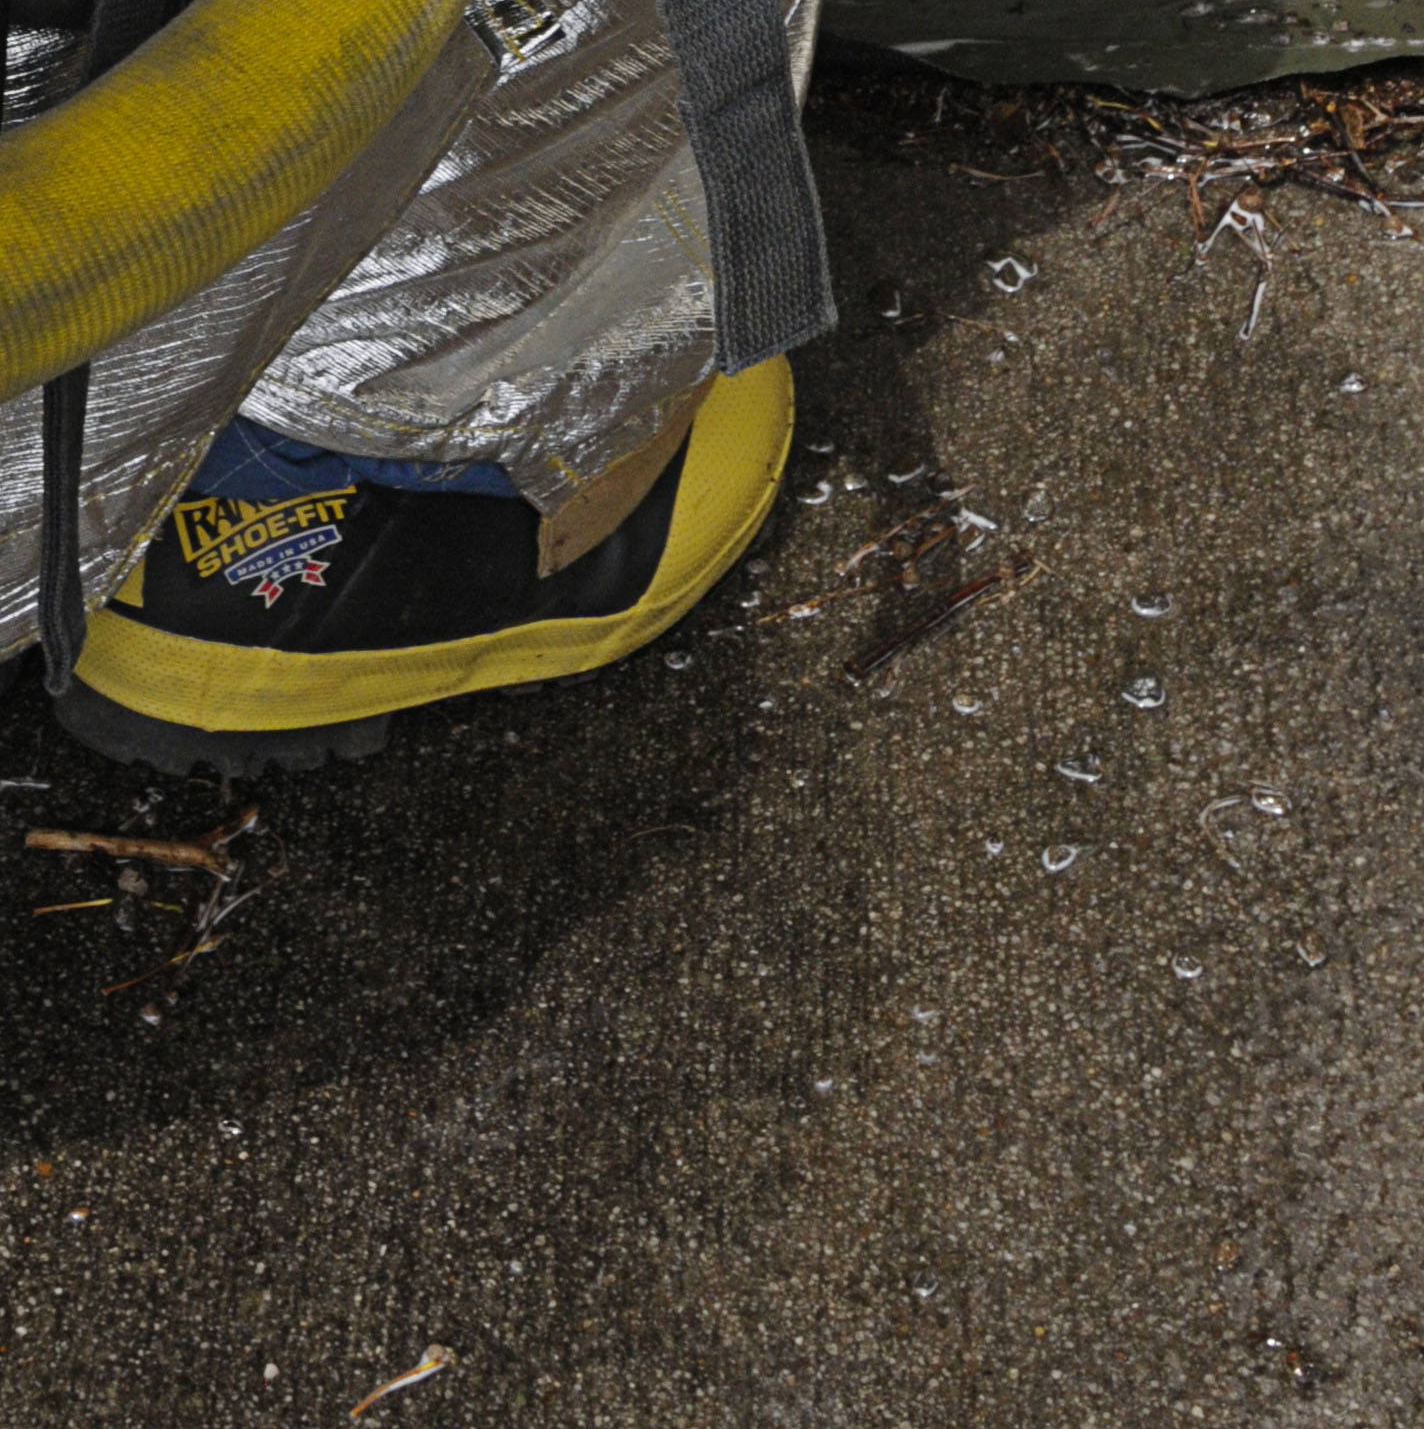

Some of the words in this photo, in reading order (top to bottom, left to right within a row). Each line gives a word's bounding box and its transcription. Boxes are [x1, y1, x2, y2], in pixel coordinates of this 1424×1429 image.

[196, 498, 348, 579] SHOE-FIT
[237, 556, 274, 576] MADE
[279, 547, 295, 559] IN
[299, 534, 326, 550] USA
